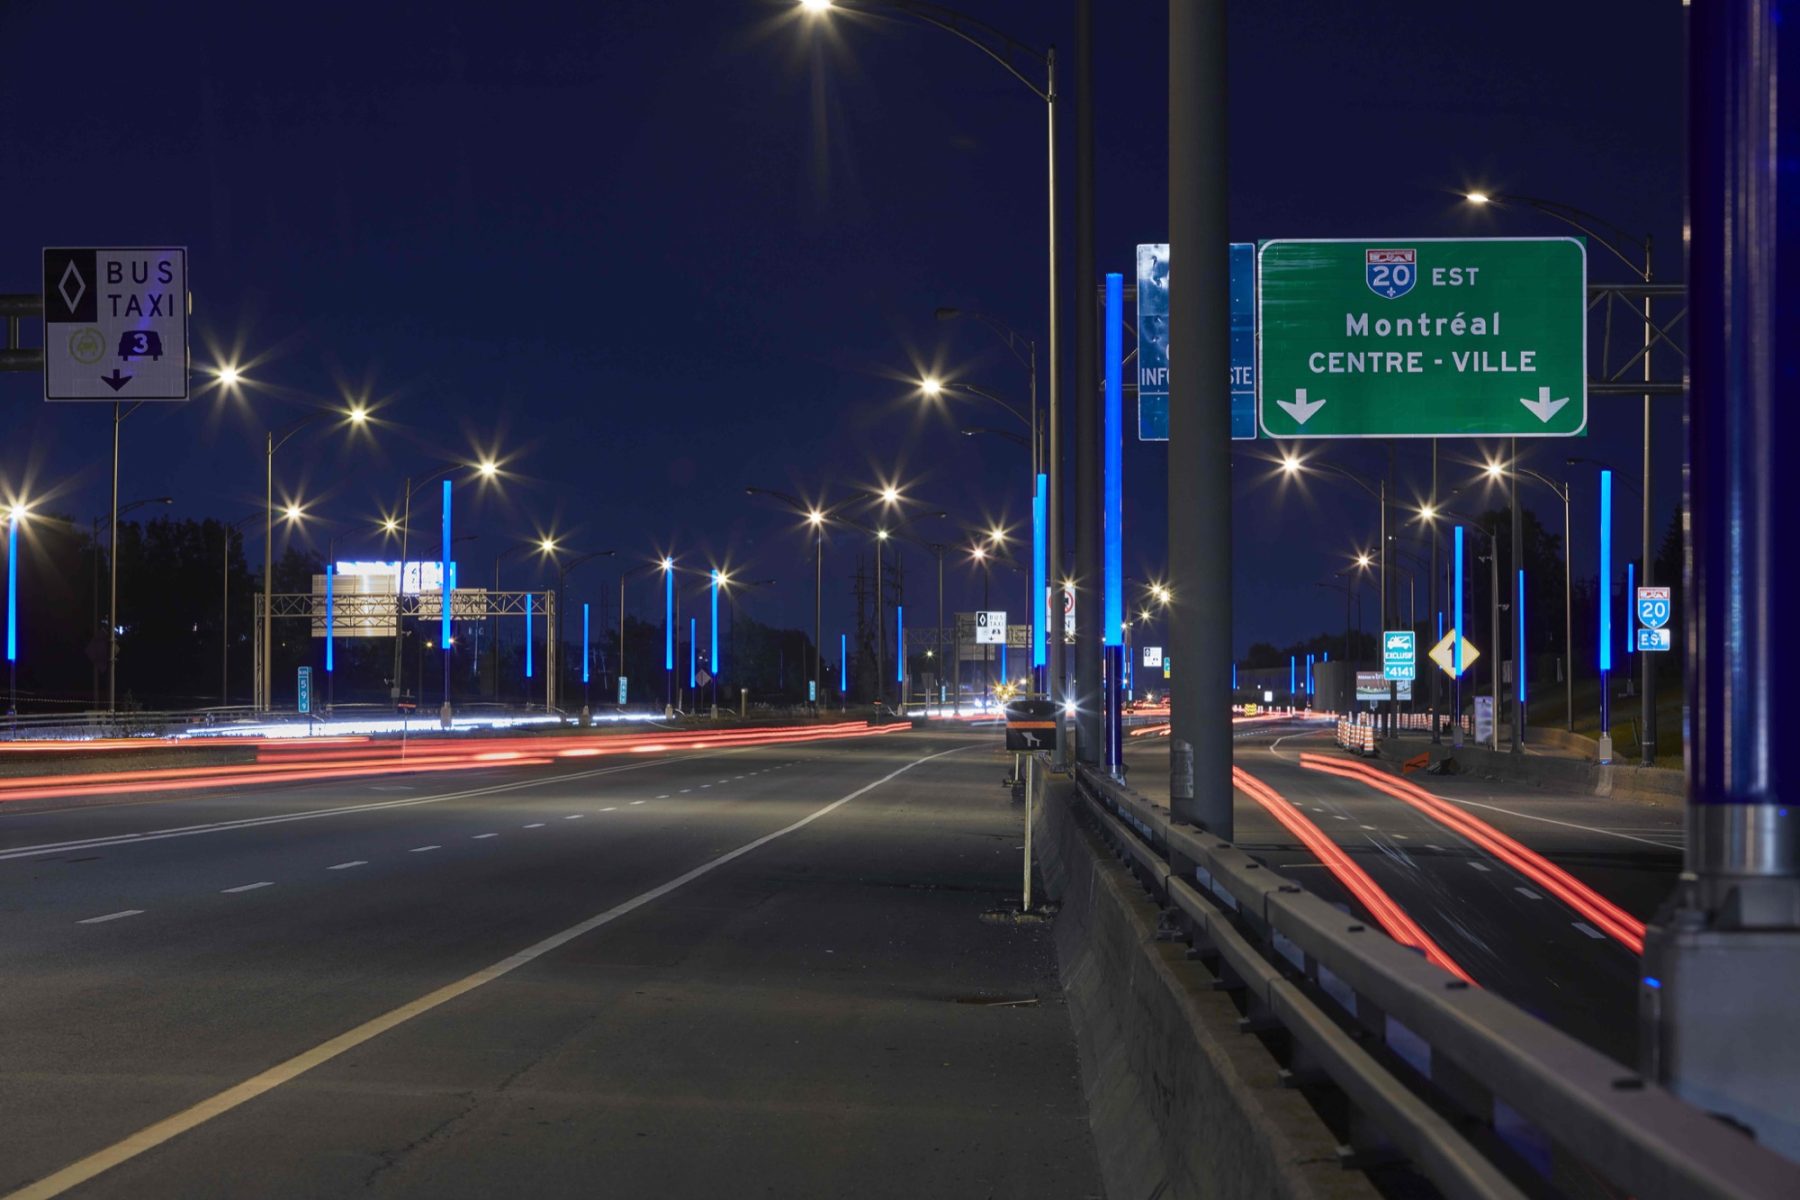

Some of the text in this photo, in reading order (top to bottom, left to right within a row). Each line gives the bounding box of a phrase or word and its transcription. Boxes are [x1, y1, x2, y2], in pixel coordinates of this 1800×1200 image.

[107, 261, 173, 284] BUS
[1373, 265, 1479, 287] 20 EST
[108, 294, 173, 317] TAXI
[1346, 311, 1500, 337] Montréal
[132, 333, 149, 354] 3
[1308, 351, 1423, 373] CENTRE
[1452, 350, 1537, 373] VILLE
[1141, 367, 1169, 386] INF
[1642, 602, 1666, 618] 20
